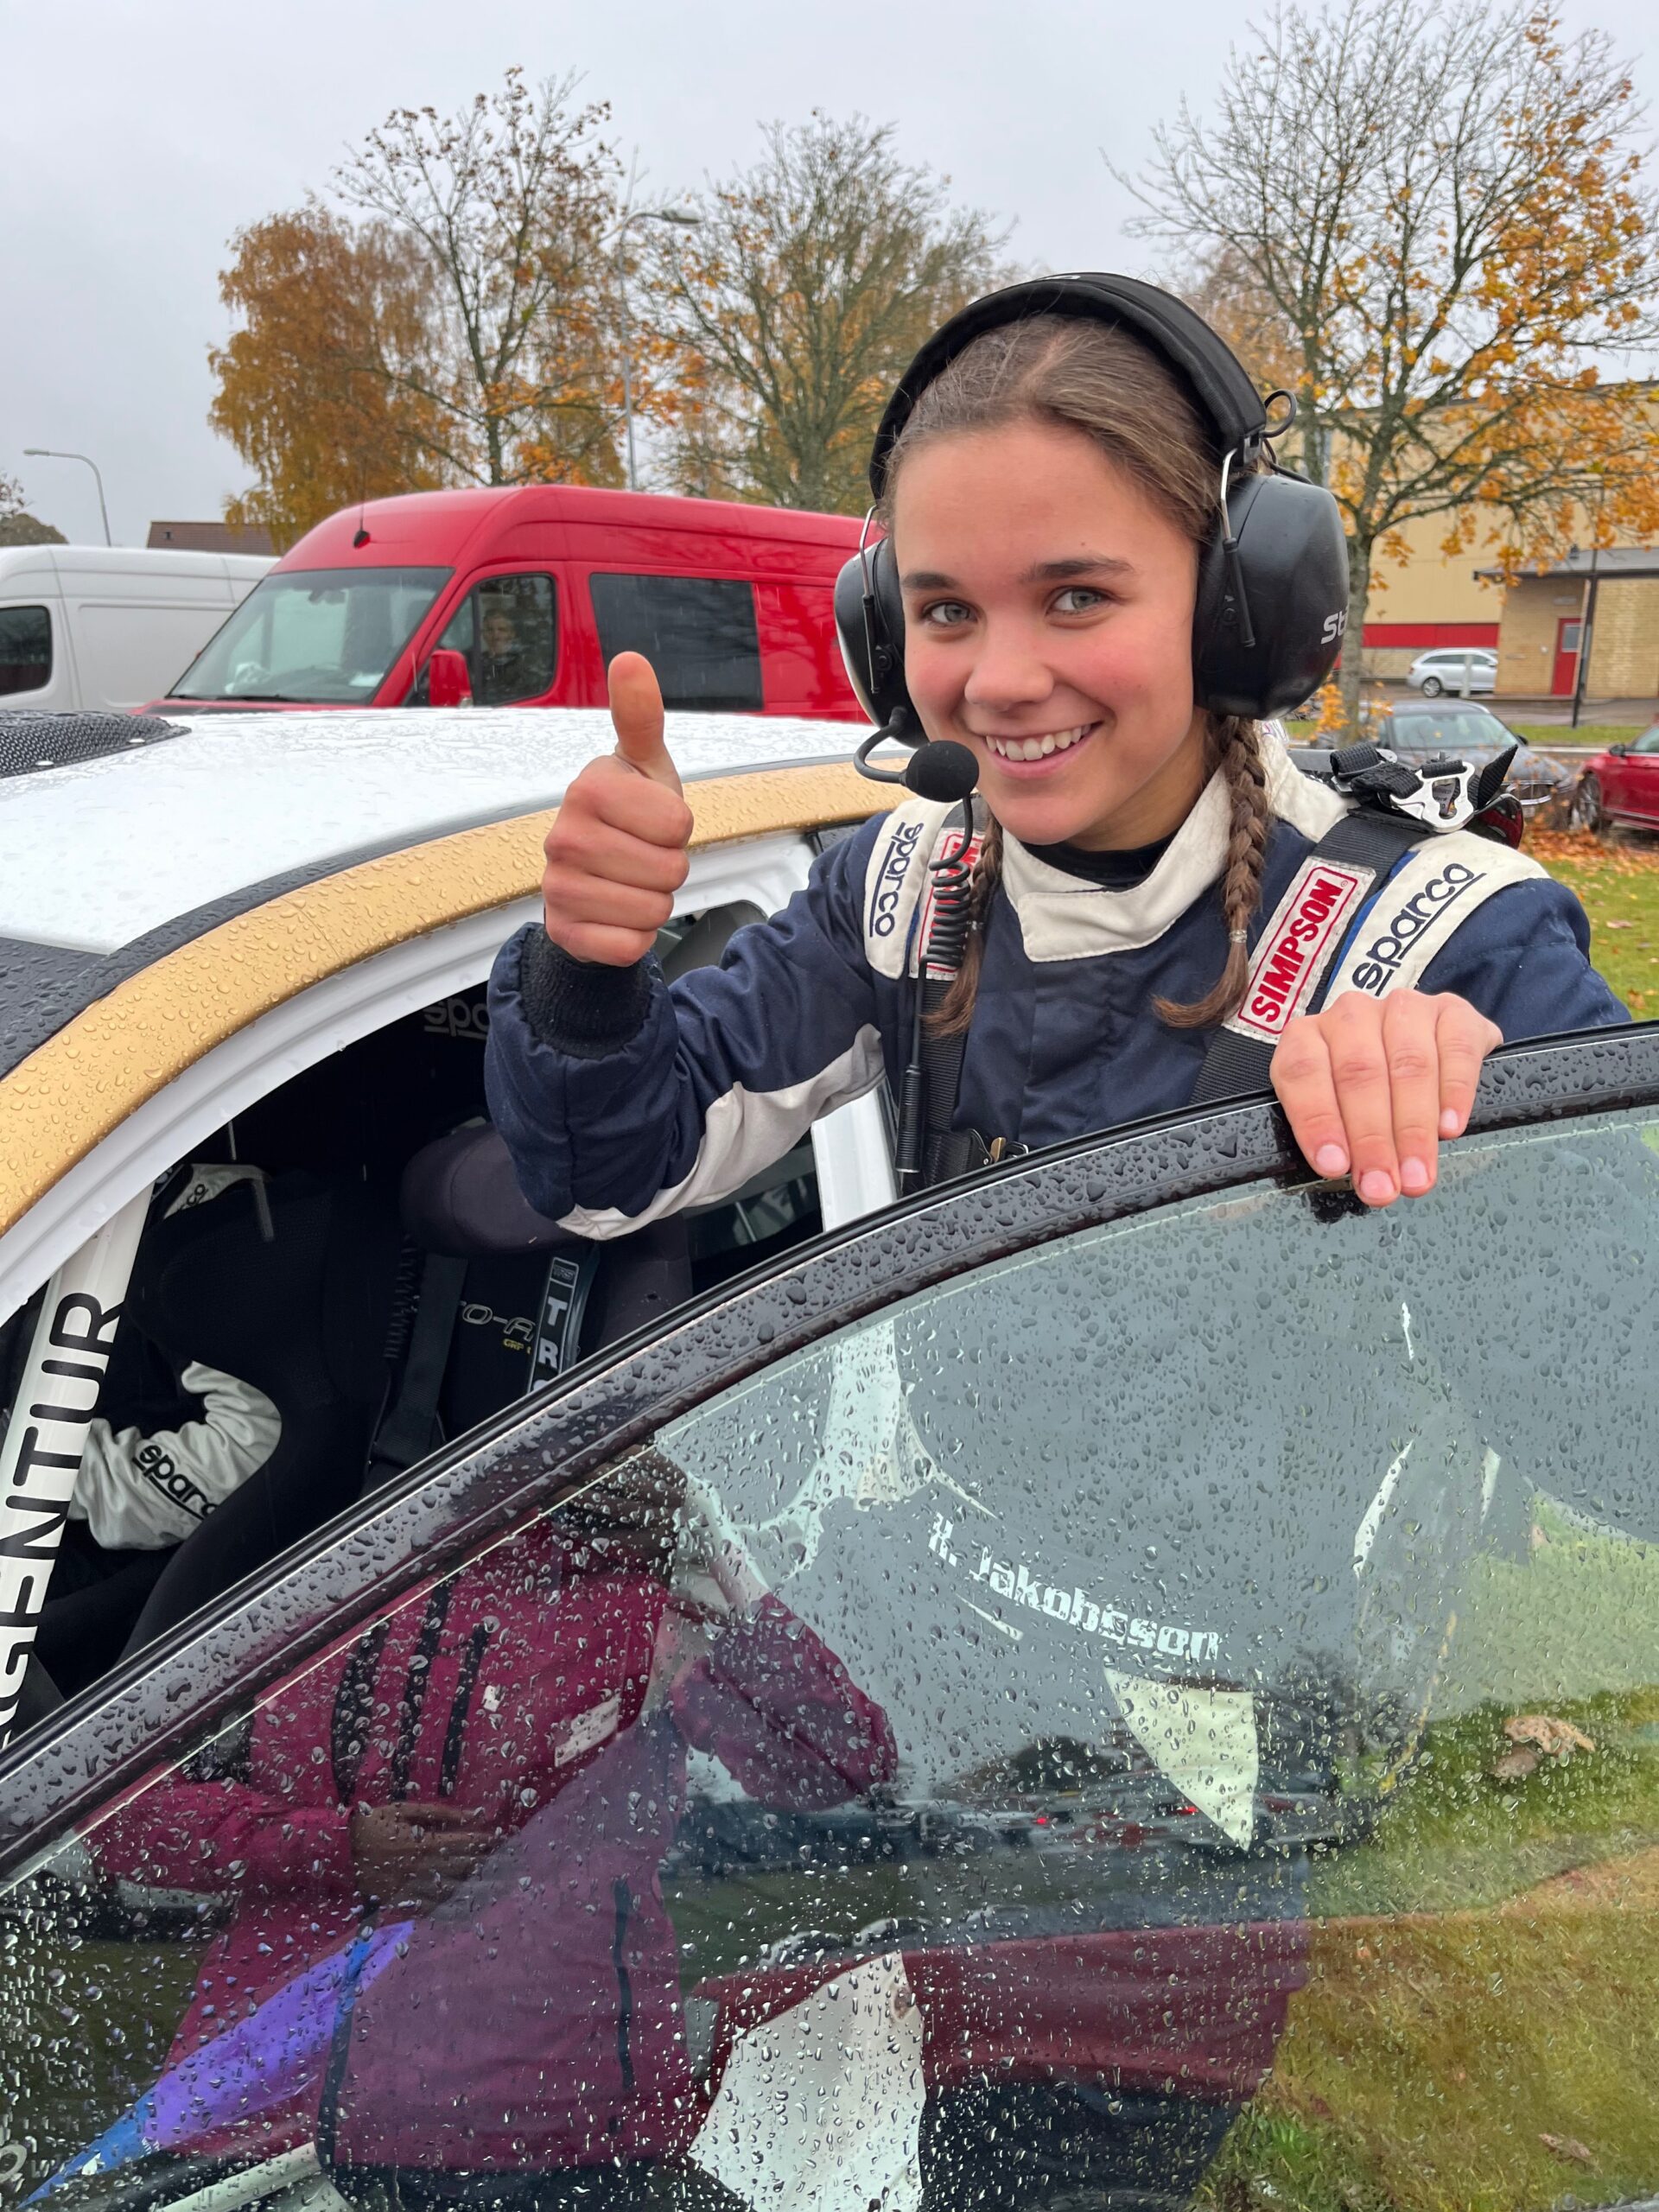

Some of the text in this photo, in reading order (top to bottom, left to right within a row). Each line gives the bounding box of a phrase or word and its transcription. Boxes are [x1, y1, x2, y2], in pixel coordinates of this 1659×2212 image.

[871, 822, 925, 938] sparco
[1351, 862, 1478, 992] sparco
[1251, 877, 1341, 1023] SIMPSON
[969, 1545, 1219, 1661] Jakobsson
